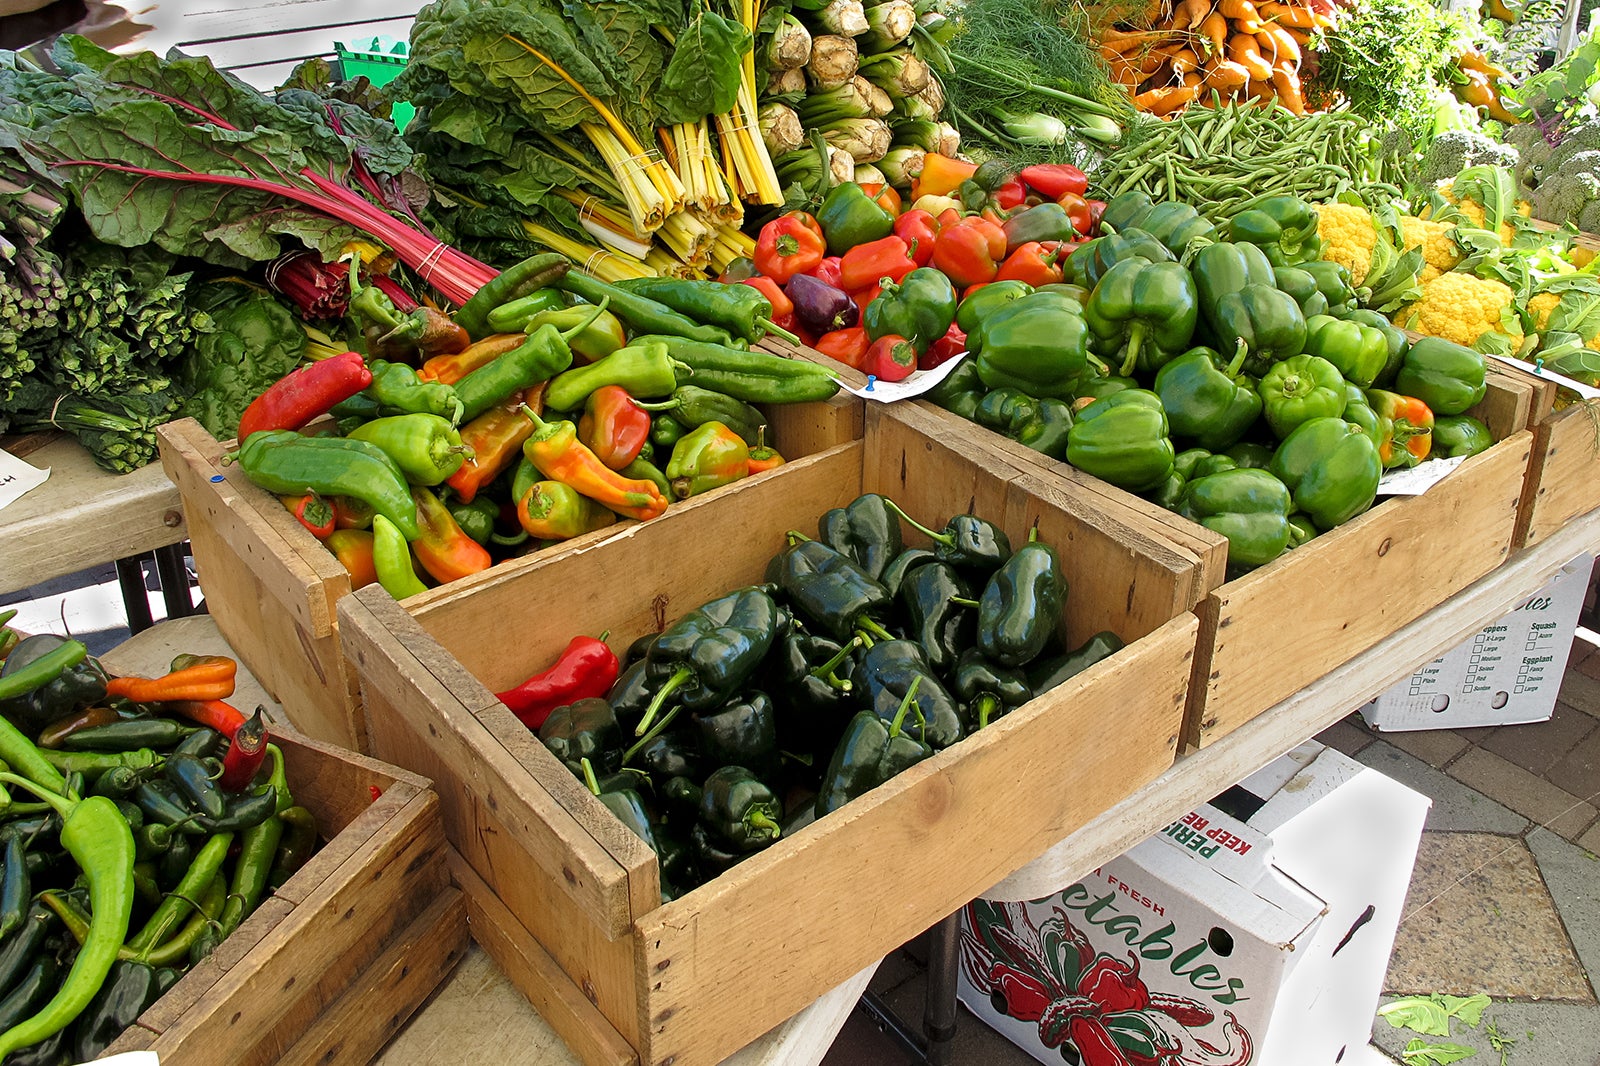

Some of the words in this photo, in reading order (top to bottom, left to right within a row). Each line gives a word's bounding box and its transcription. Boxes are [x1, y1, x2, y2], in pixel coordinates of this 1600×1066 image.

[1515, 597, 1552, 611] les
[1483, 625, 1508, 633] eppers
[1531, 622, 1557, 631] Squash
[1522, 655, 1553, 665] Eggplant
[1180, 811, 1210, 831] RE
[1206, 828, 1253, 856] KEEP
[1107, 875, 1165, 917] FRESH
[1030, 883, 1250, 1005] etables
